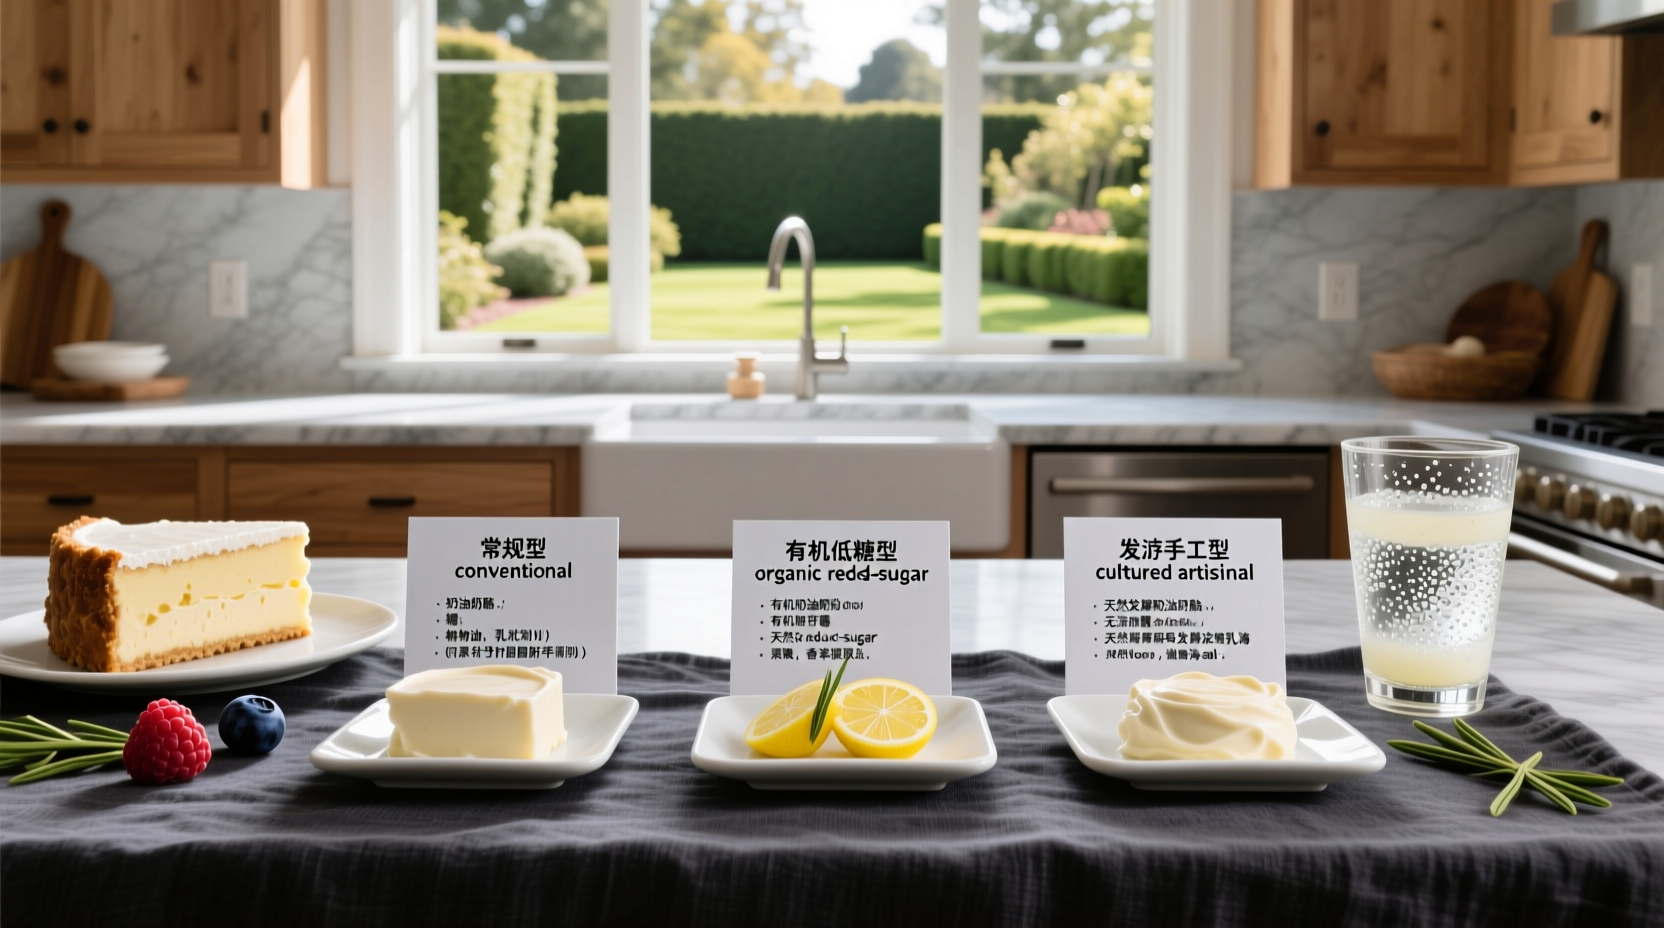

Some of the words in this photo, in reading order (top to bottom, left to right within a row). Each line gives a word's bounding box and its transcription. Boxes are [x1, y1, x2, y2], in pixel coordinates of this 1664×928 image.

[480, 536, 546, 560] 常规型
[785, 539, 898, 562] 有机低糖型
[455, 561, 572, 579] conventional
[755, 564, 822, 585] organic
[1095, 563, 1172, 580] cultured
[1177, 563, 1254, 581] artisinal
